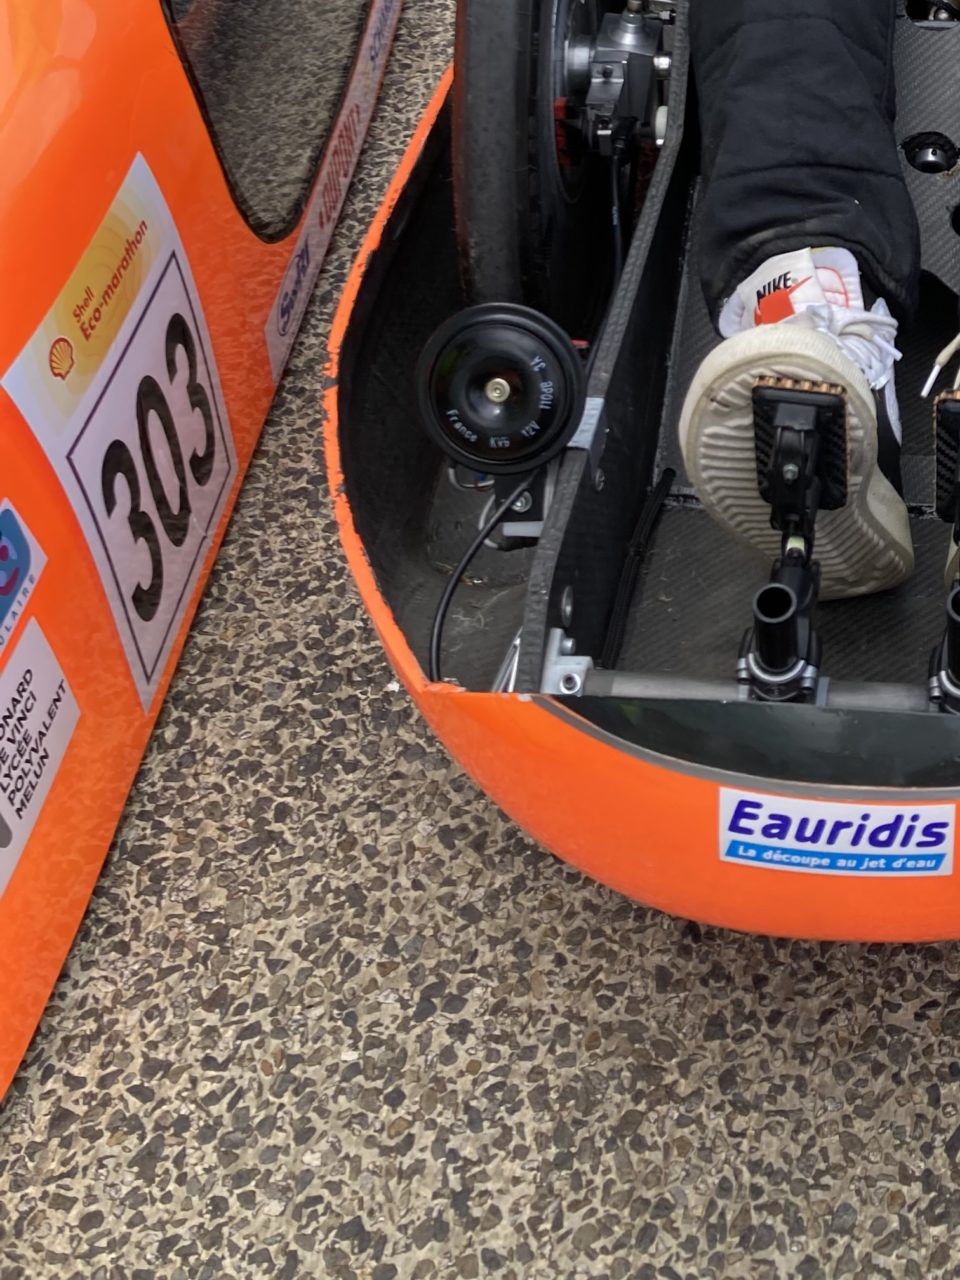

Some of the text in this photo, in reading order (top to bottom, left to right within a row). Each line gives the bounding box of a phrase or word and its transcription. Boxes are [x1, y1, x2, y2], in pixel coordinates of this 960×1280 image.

[72, 285, 95, 323] Shell
[79, 219, 149, 342] Eco-marathon
[756, 270, 792, 306] NIKE
[446, 408, 479, 443] France
[530, 355, 547, 372] 3A
[102, 313, 215, 622] 303
[0, 668, 33, 742] ONARD
[6, 690, 38, 746] VINCI
[0, 728, 33, 794] LYCÉE
[7, 678, 67, 807] POLYVALENT
[14, 747, 50, 820] MELUN
[728, 799, 949, 848] Eauridis
[738, 844, 937, 870] La découpe au jet d'eau
